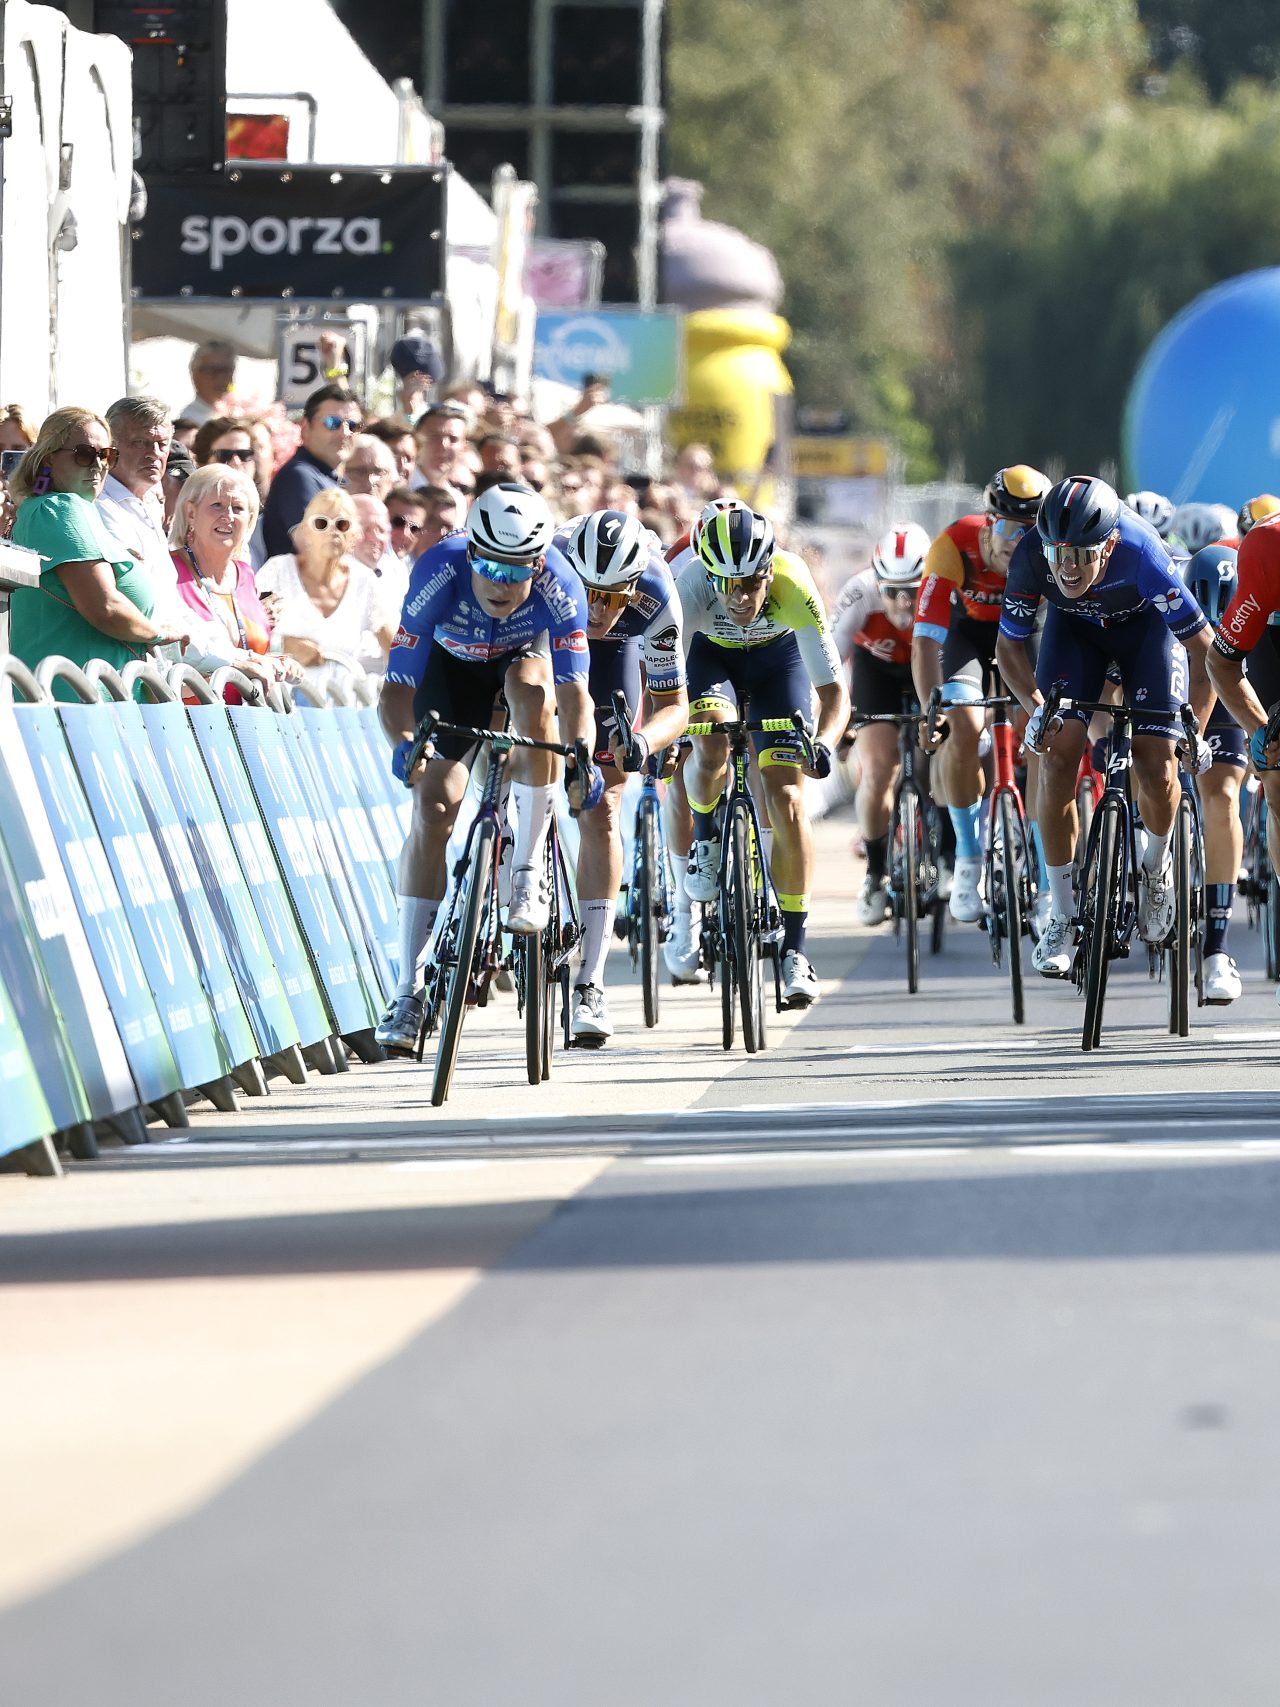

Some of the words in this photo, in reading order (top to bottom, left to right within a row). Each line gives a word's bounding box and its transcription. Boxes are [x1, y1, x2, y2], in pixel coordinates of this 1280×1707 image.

[406, 562, 457, 618] deceuninck
[1170, 655, 1186, 703] FDJ
[736, 755, 745, 793] CUBE
